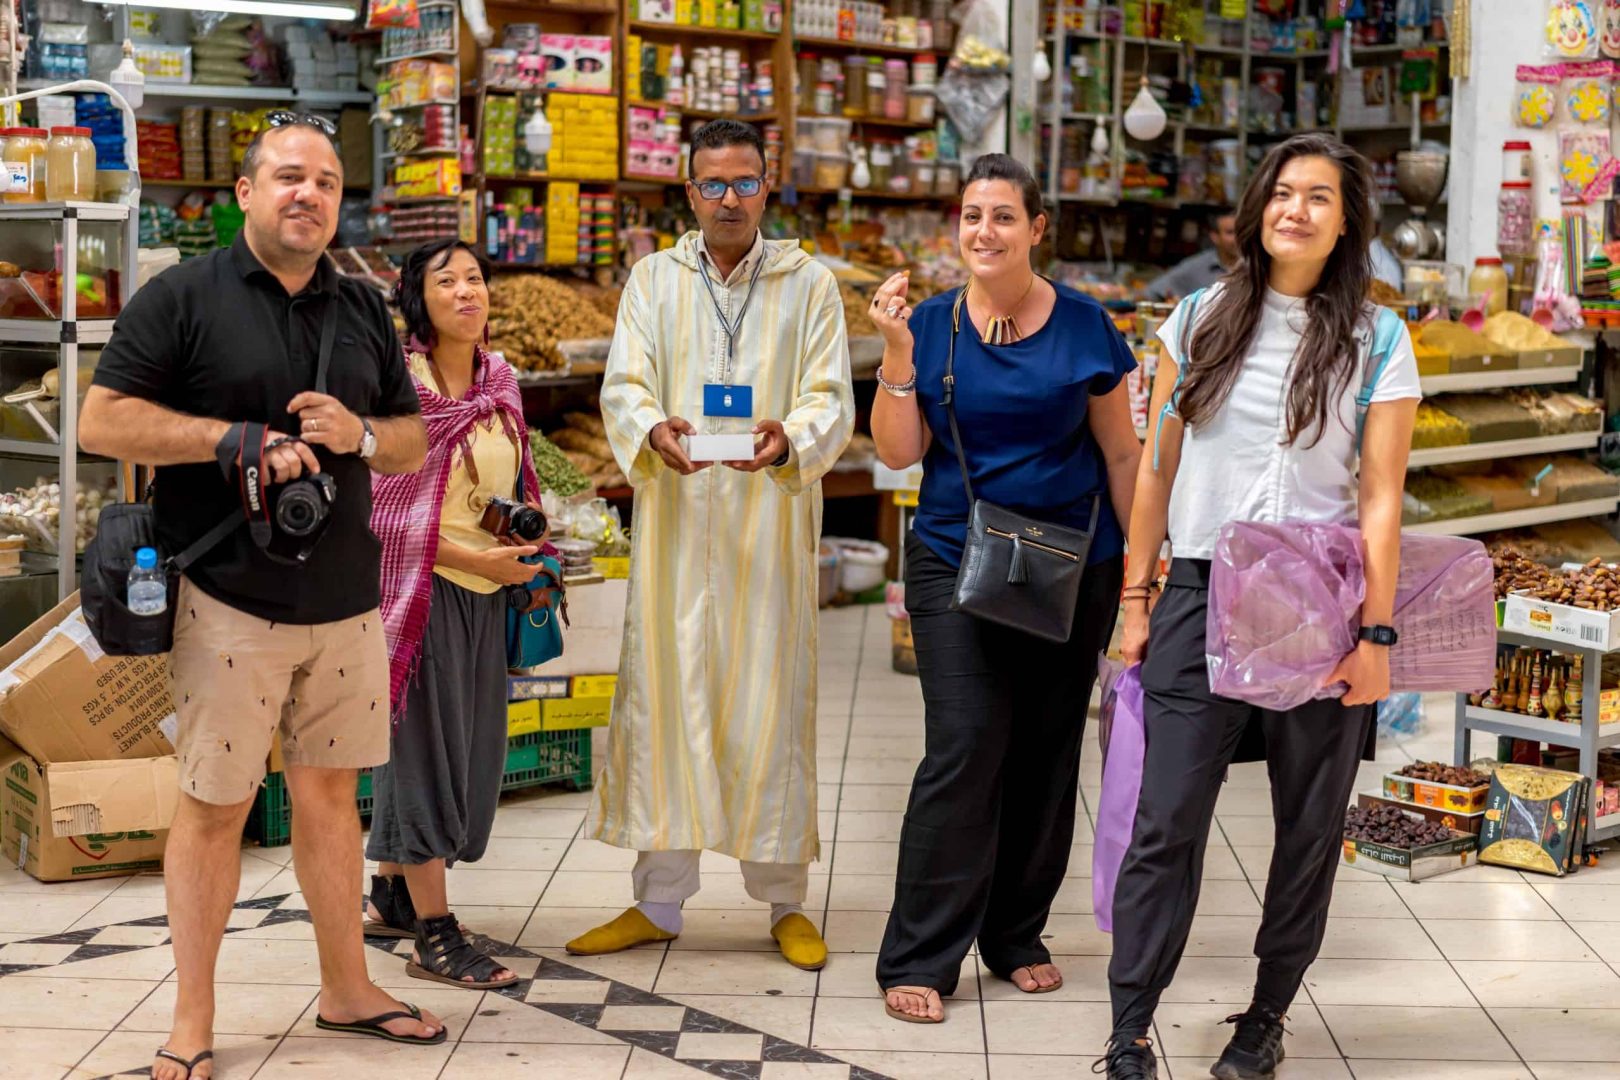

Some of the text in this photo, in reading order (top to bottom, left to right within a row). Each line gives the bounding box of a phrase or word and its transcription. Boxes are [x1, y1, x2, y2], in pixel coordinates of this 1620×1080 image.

[246, 466, 261, 511] Canon
[115, 661, 127, 673] BE
[132, 661, 149, 676] KGS
[96, 668, 117, 688] USED
[143, 669, 159, 685] PER
[82, 698, 101, 714] KGS
[89, 713, 106, 726] PCS
[112, 708, 152, 740] PRODUCTS
[118, 724, 152, 753] BLANKET
